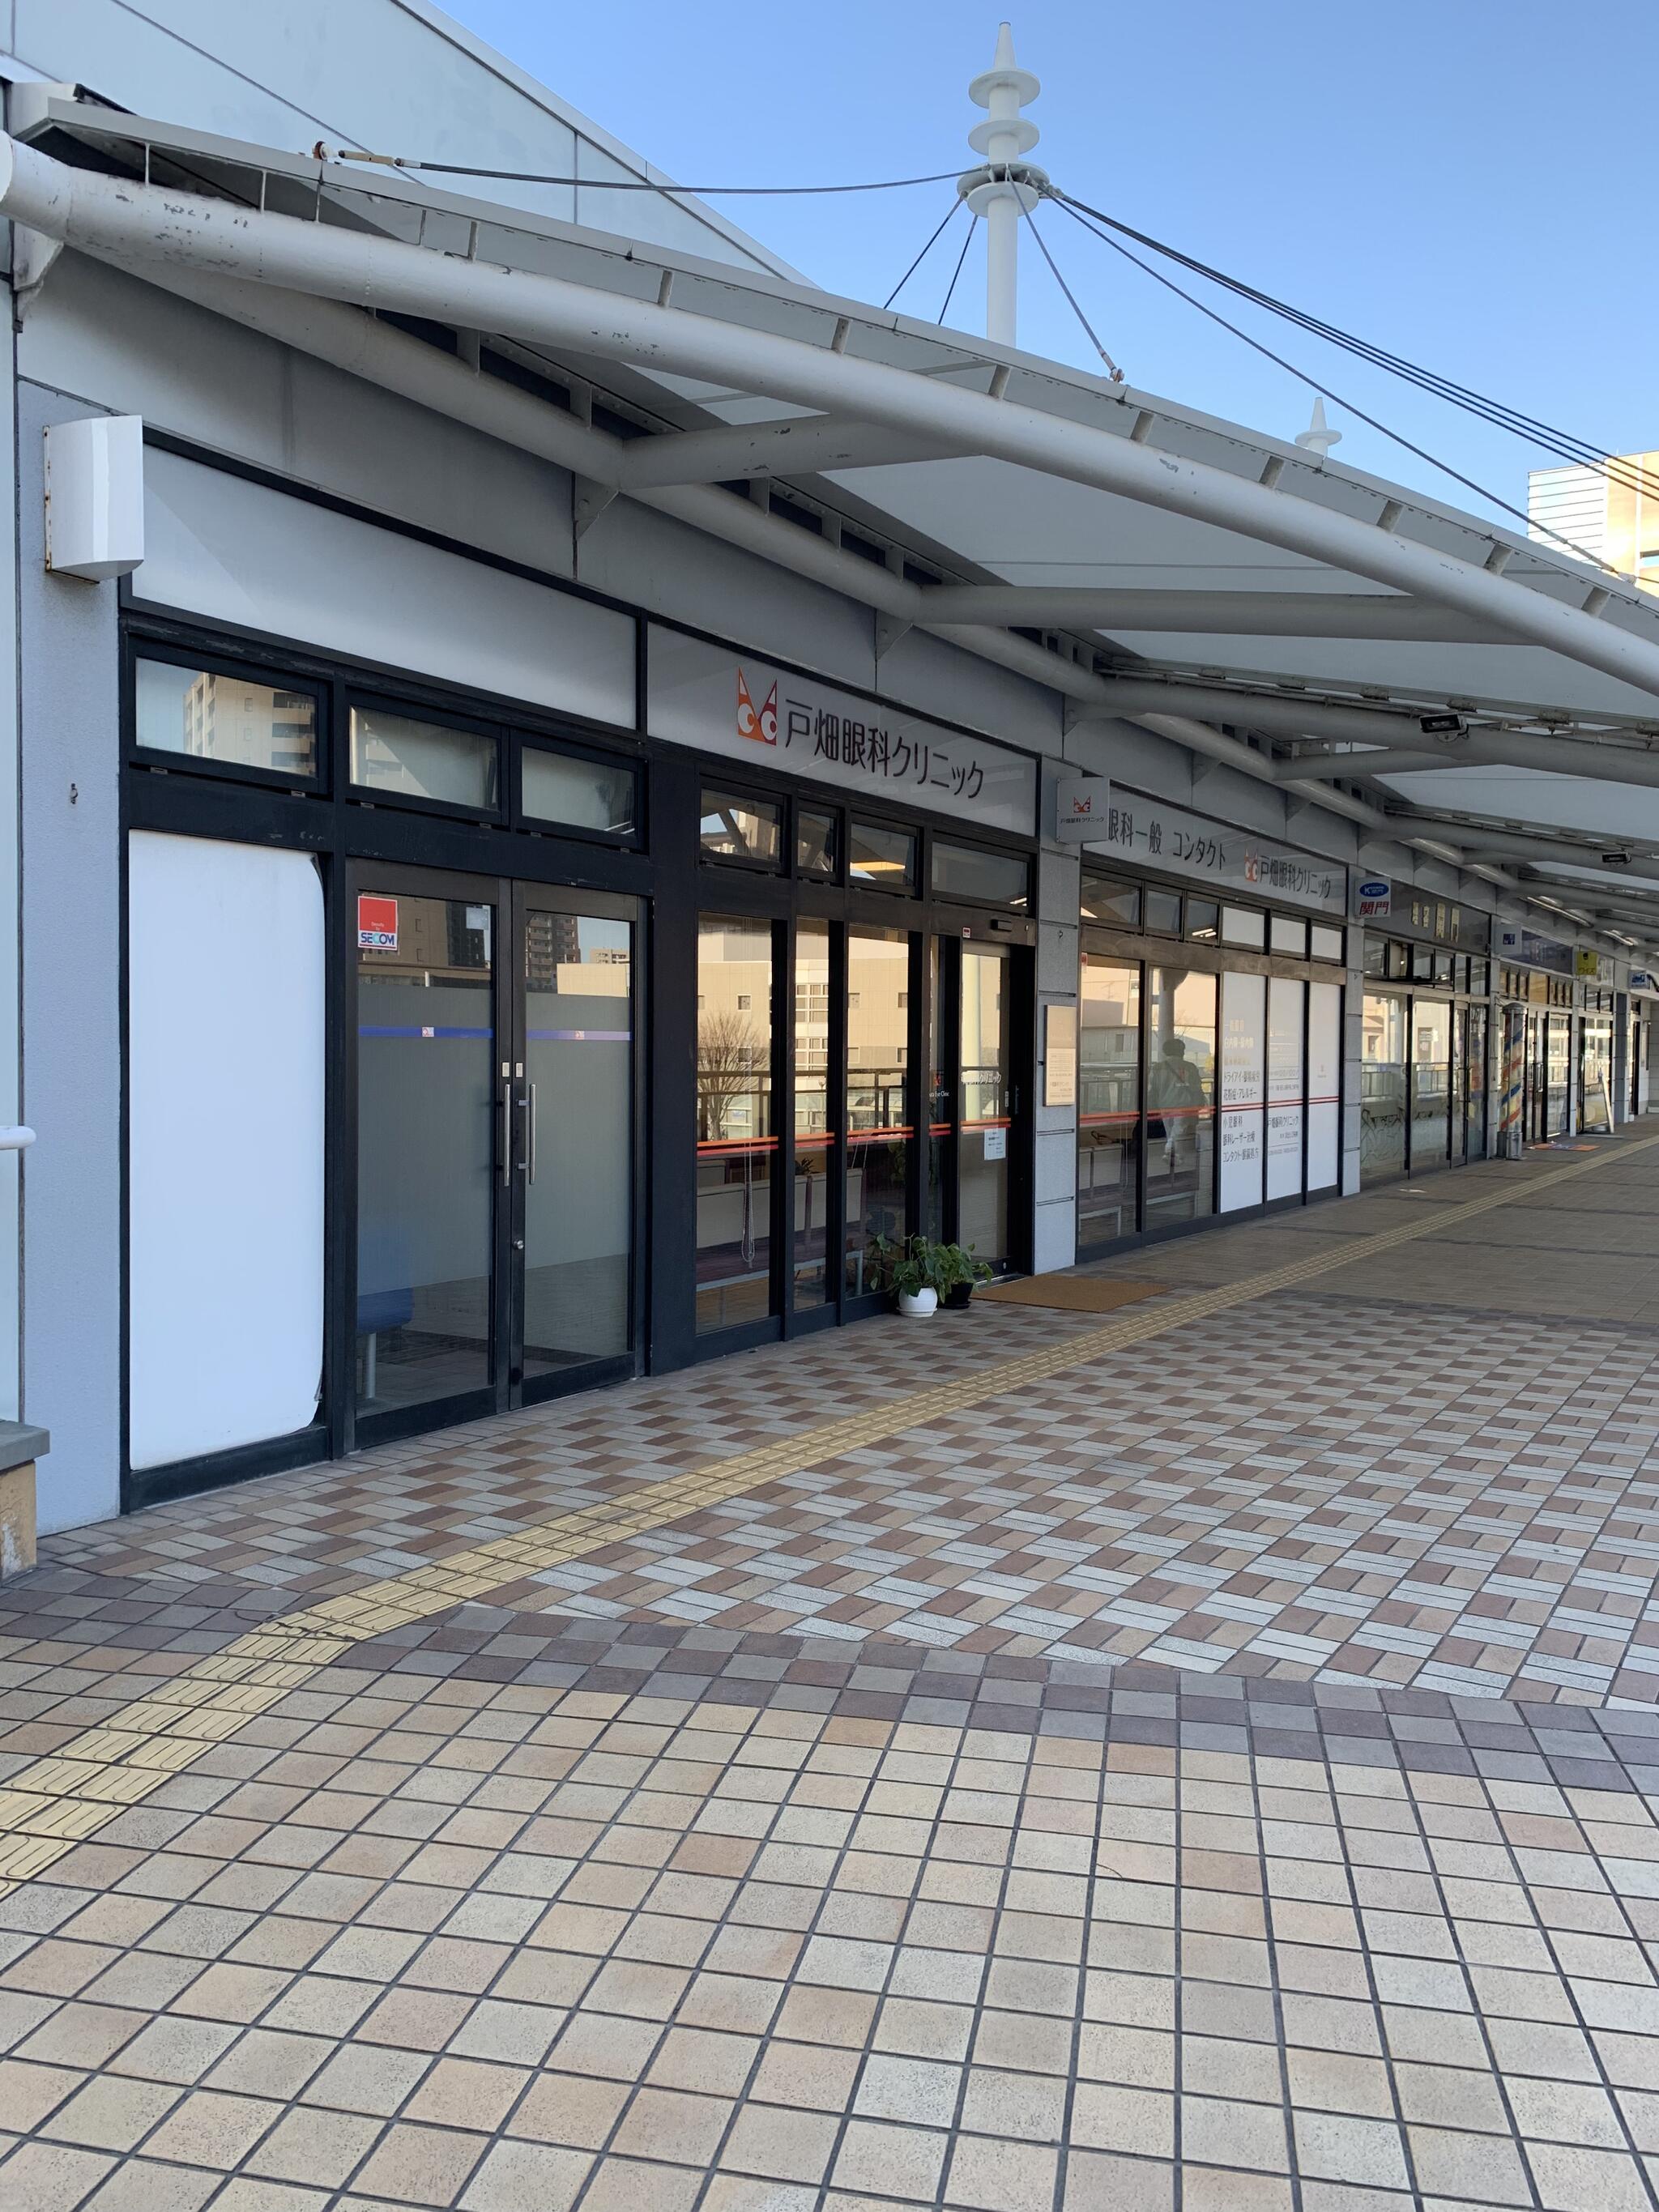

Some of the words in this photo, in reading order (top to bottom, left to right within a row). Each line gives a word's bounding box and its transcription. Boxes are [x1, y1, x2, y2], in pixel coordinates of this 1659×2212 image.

[785, 698, 983, 799] 戸畑眼科クリニック
[1172, 831, 1226, 871] コンタクト
[1260, 855, 1331, 899] 戸畑眼科クリニック
[1359, 901, 1390, 915] 関門
[360, 932, 394, 945] SECOM
